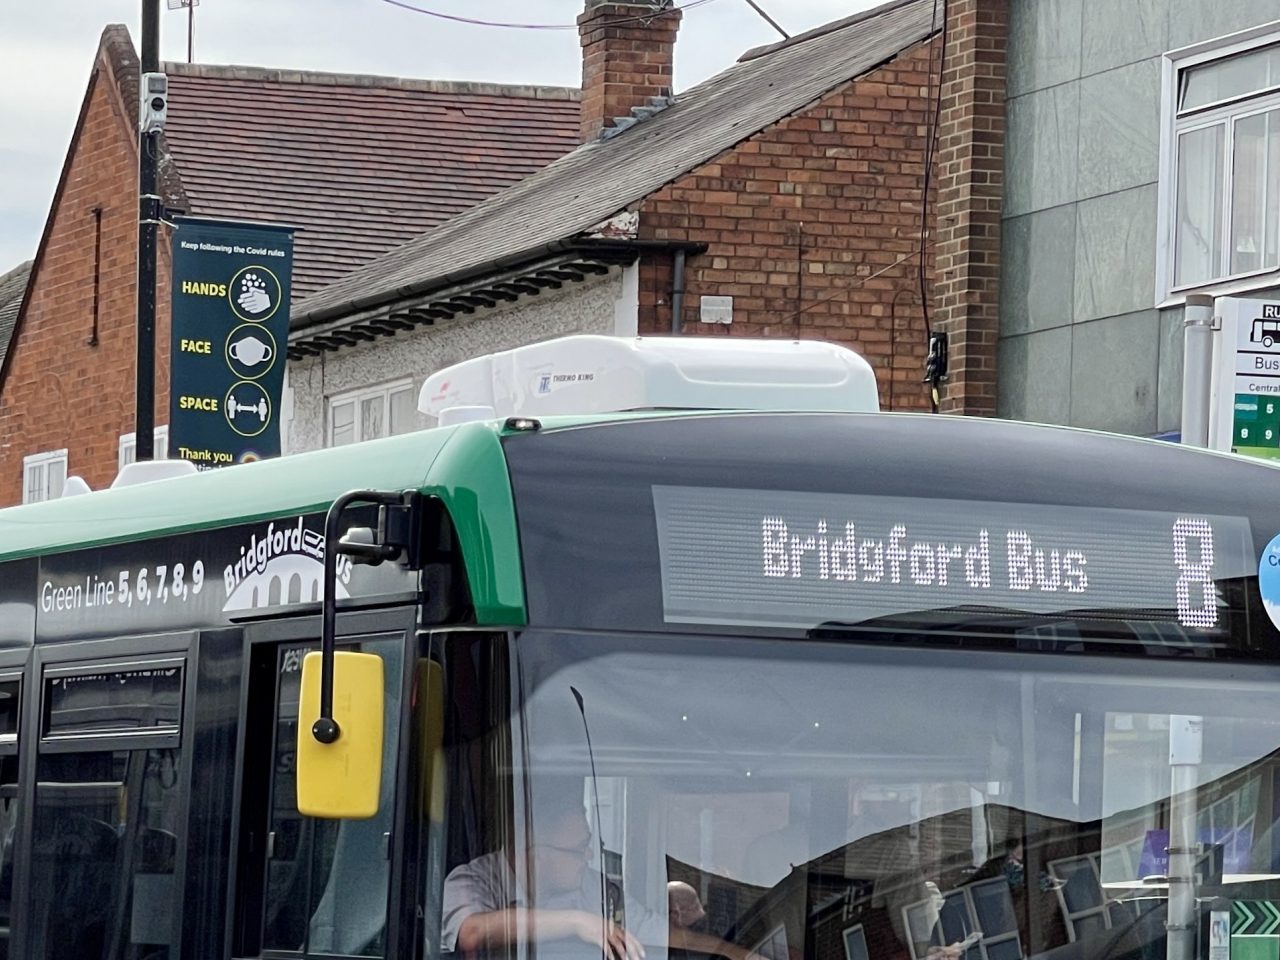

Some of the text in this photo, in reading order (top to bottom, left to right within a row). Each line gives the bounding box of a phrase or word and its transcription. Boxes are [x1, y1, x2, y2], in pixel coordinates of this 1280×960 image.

[181, 241, 285, 257] Keep following the Covid rules
[182, 281, 226, 297] HANDS
[181, 340, 211, 354] FACE
[1255, 357, 1279, 370] Bus
[180, 396, 218, 411] SPACE
[1266, 403, 1273, 414] 5
[179, 447, 233, 463] Thank you
[223, 516, 303, 598] Bridgford
[762, 515, 1218, 628] Bridgford Bus 8
[41, 580, 81, 613] Green
[85, 576, 114, 608] Line
